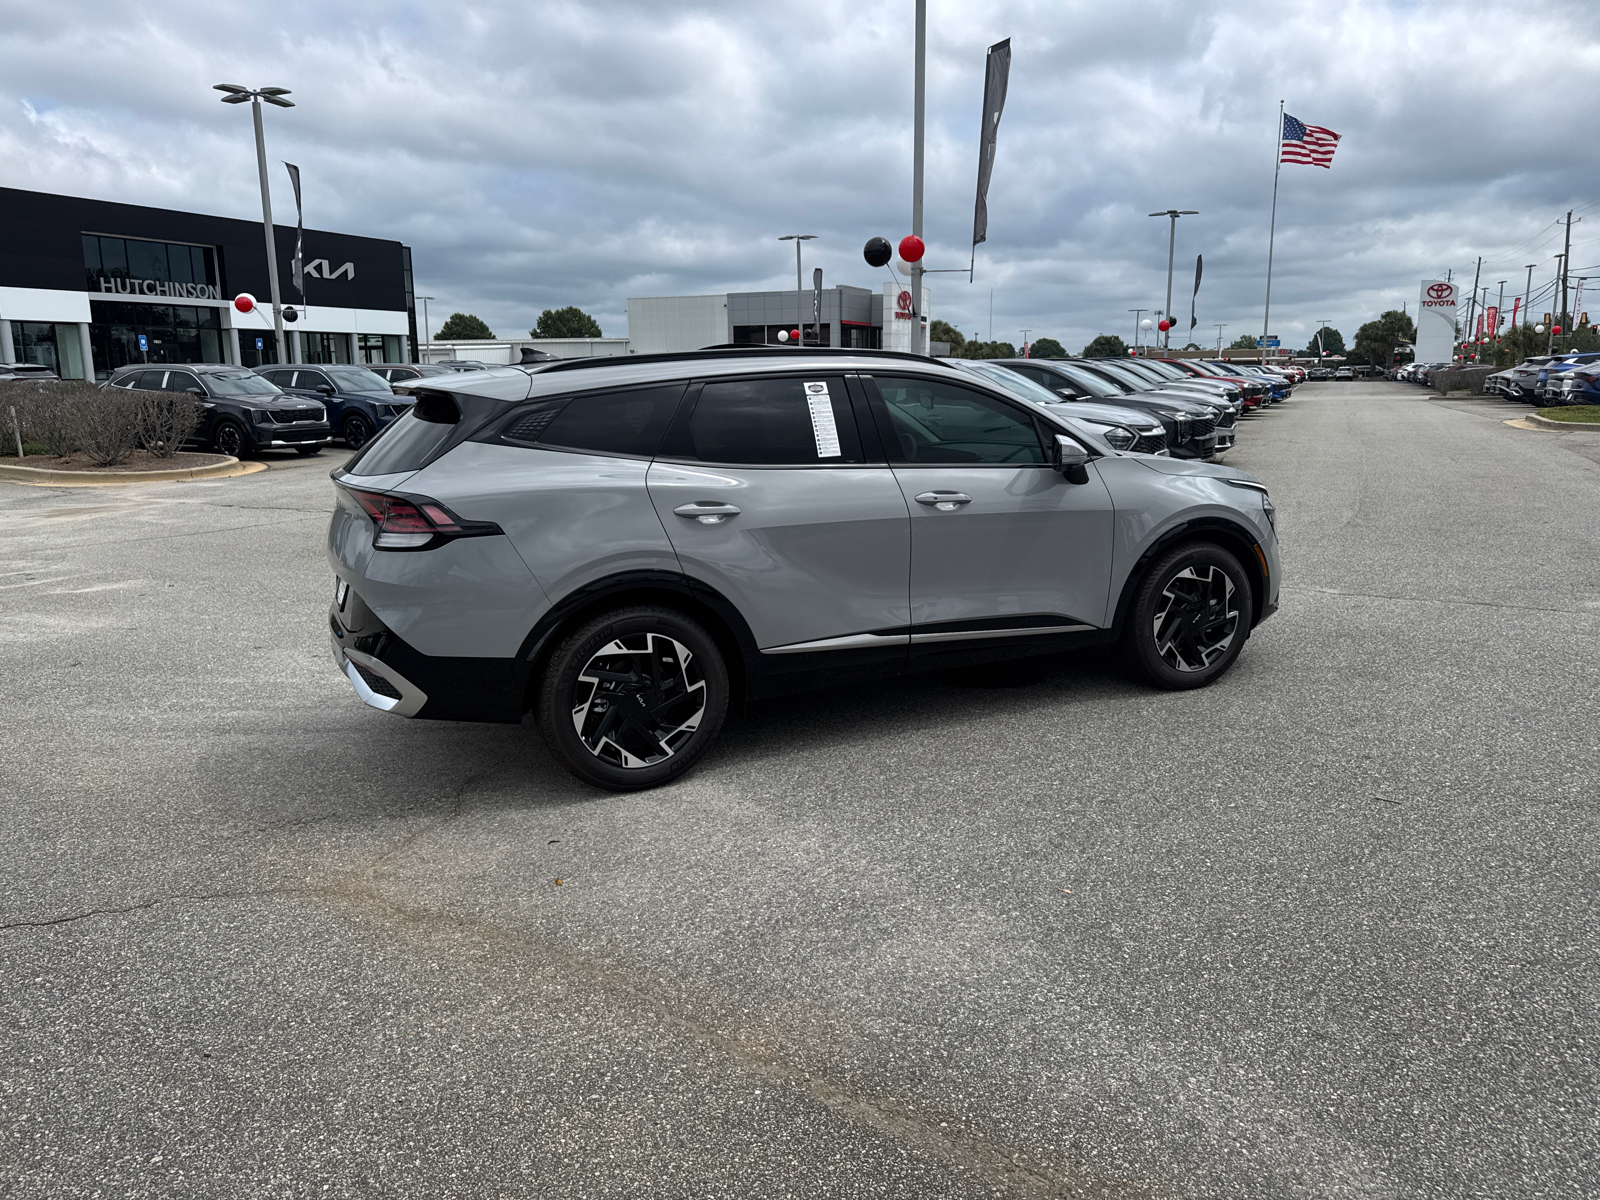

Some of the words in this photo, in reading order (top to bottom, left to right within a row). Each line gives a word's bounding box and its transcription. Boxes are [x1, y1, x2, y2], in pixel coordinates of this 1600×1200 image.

[291, 258, 355, 281] KIA
[100, 277, 220, 300] HUTCHINSON
[570, 628, 612, 668] MICHELIN
